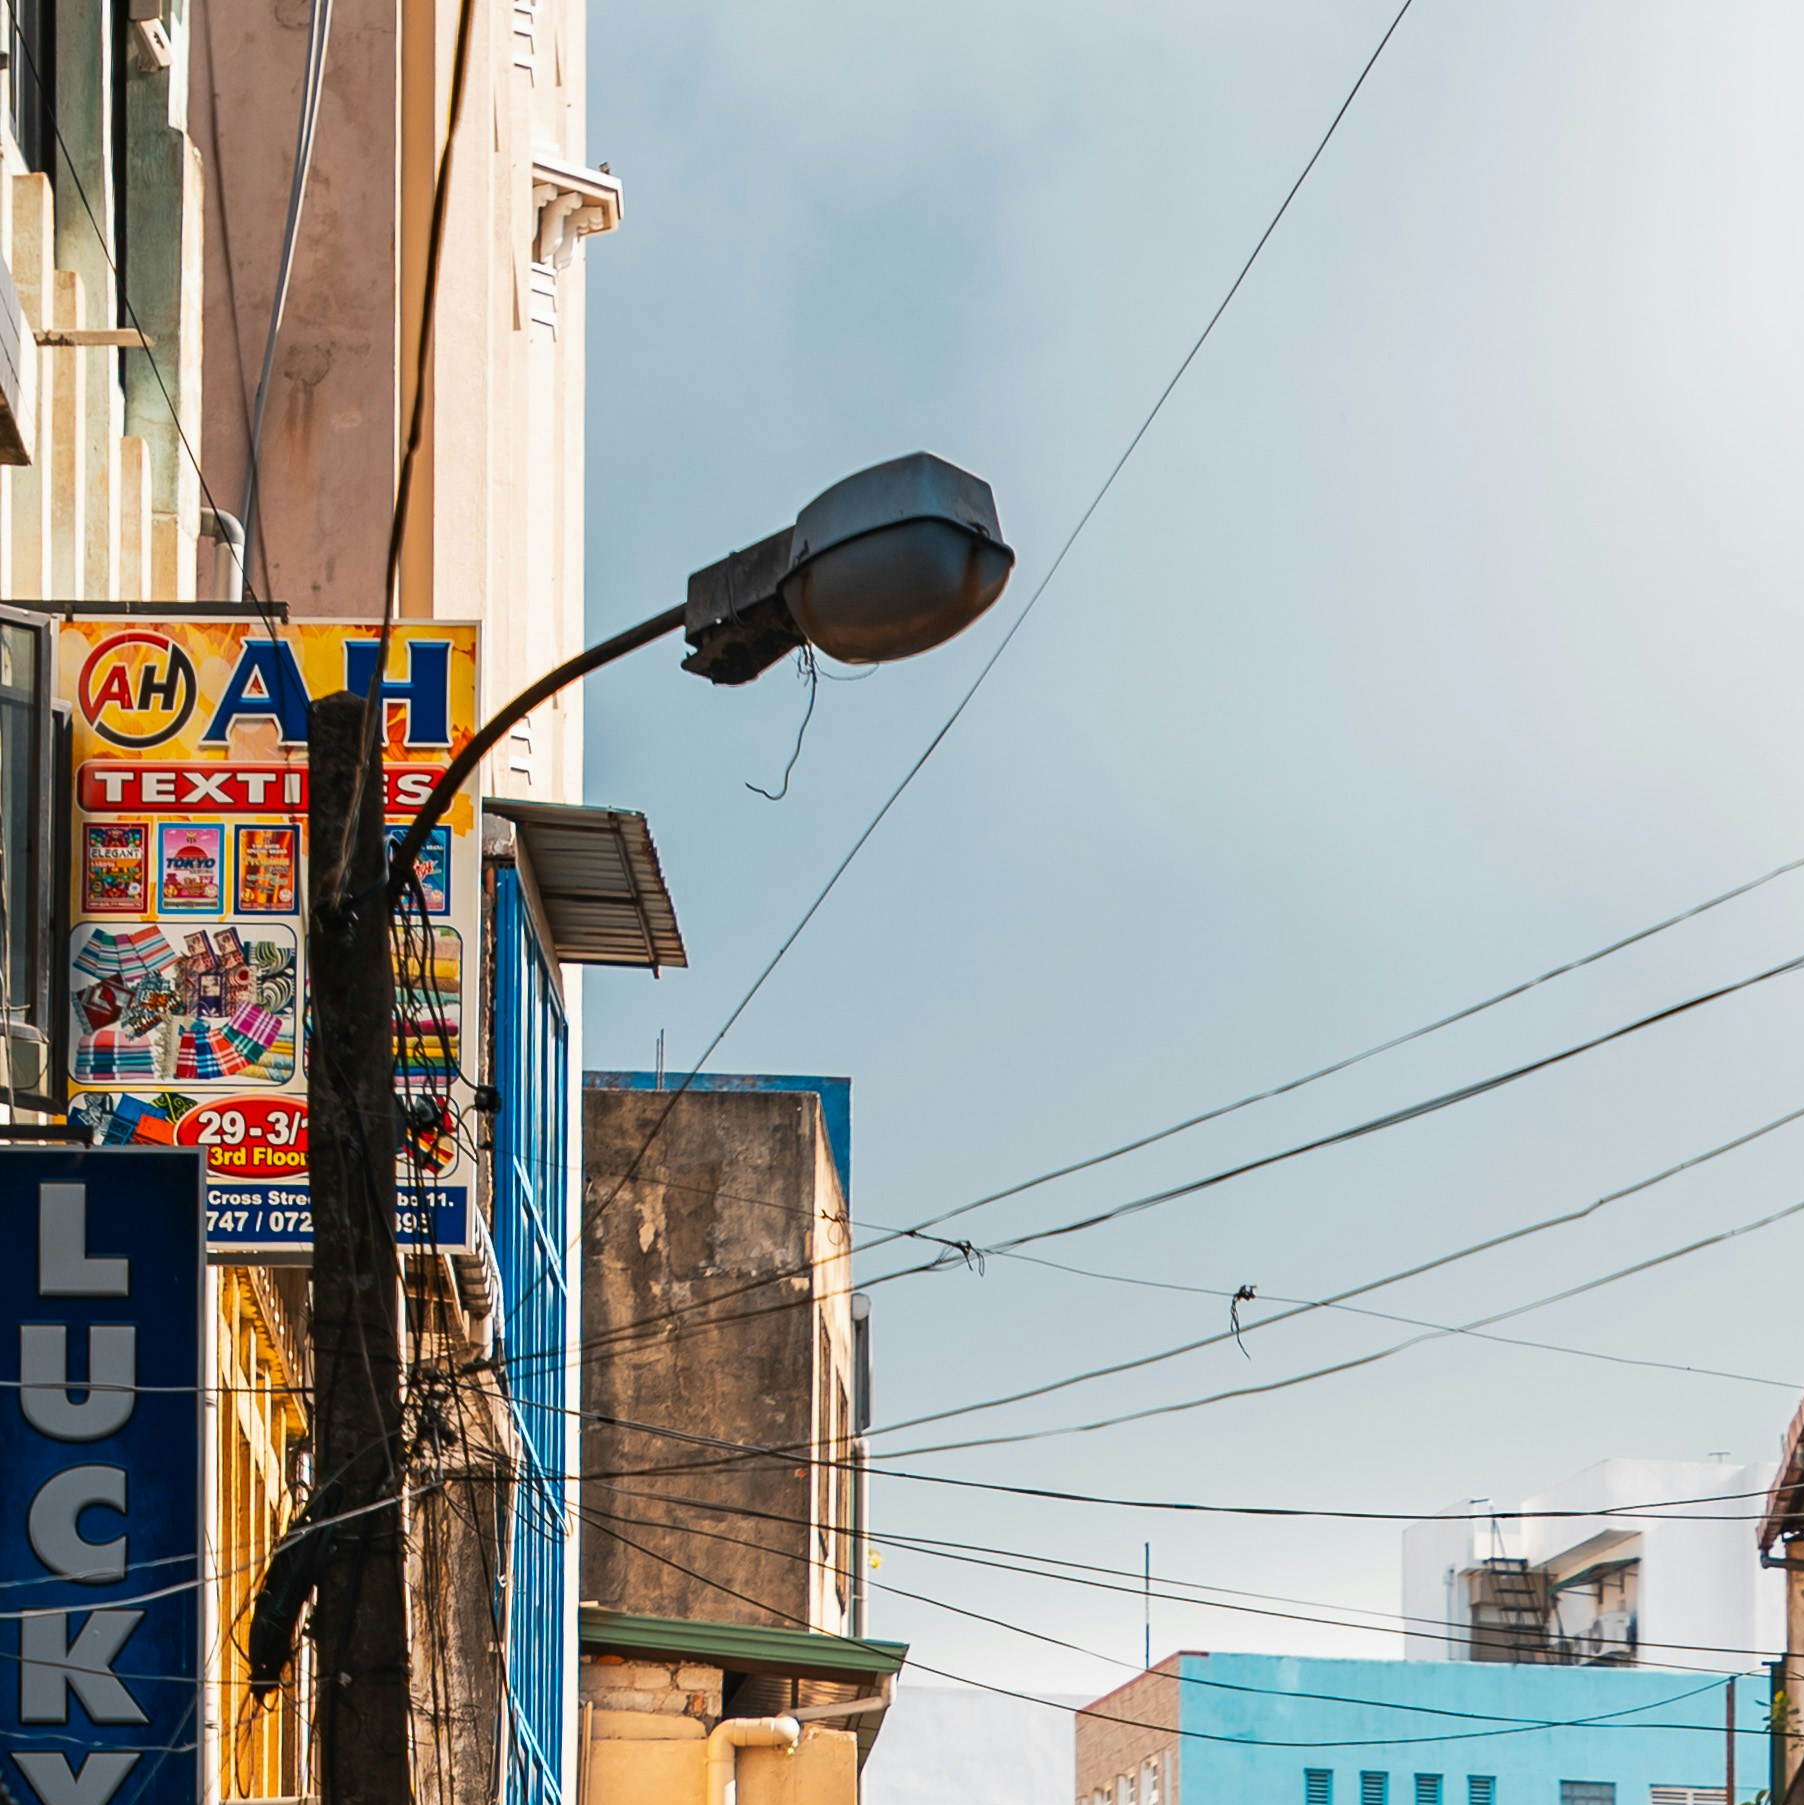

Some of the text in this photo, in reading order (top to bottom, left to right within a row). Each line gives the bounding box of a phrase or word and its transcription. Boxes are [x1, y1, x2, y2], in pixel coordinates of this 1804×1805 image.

[101, 665, 178, 712] AH
[198, 637, 454, 748] AH
[94, 770, 437, 806] TEXTIS
[166, 857, 216, 870] TOKYO
[210, 1147, 246, 1167] 3rd
[208, 1190, 262, 1206] Cross
